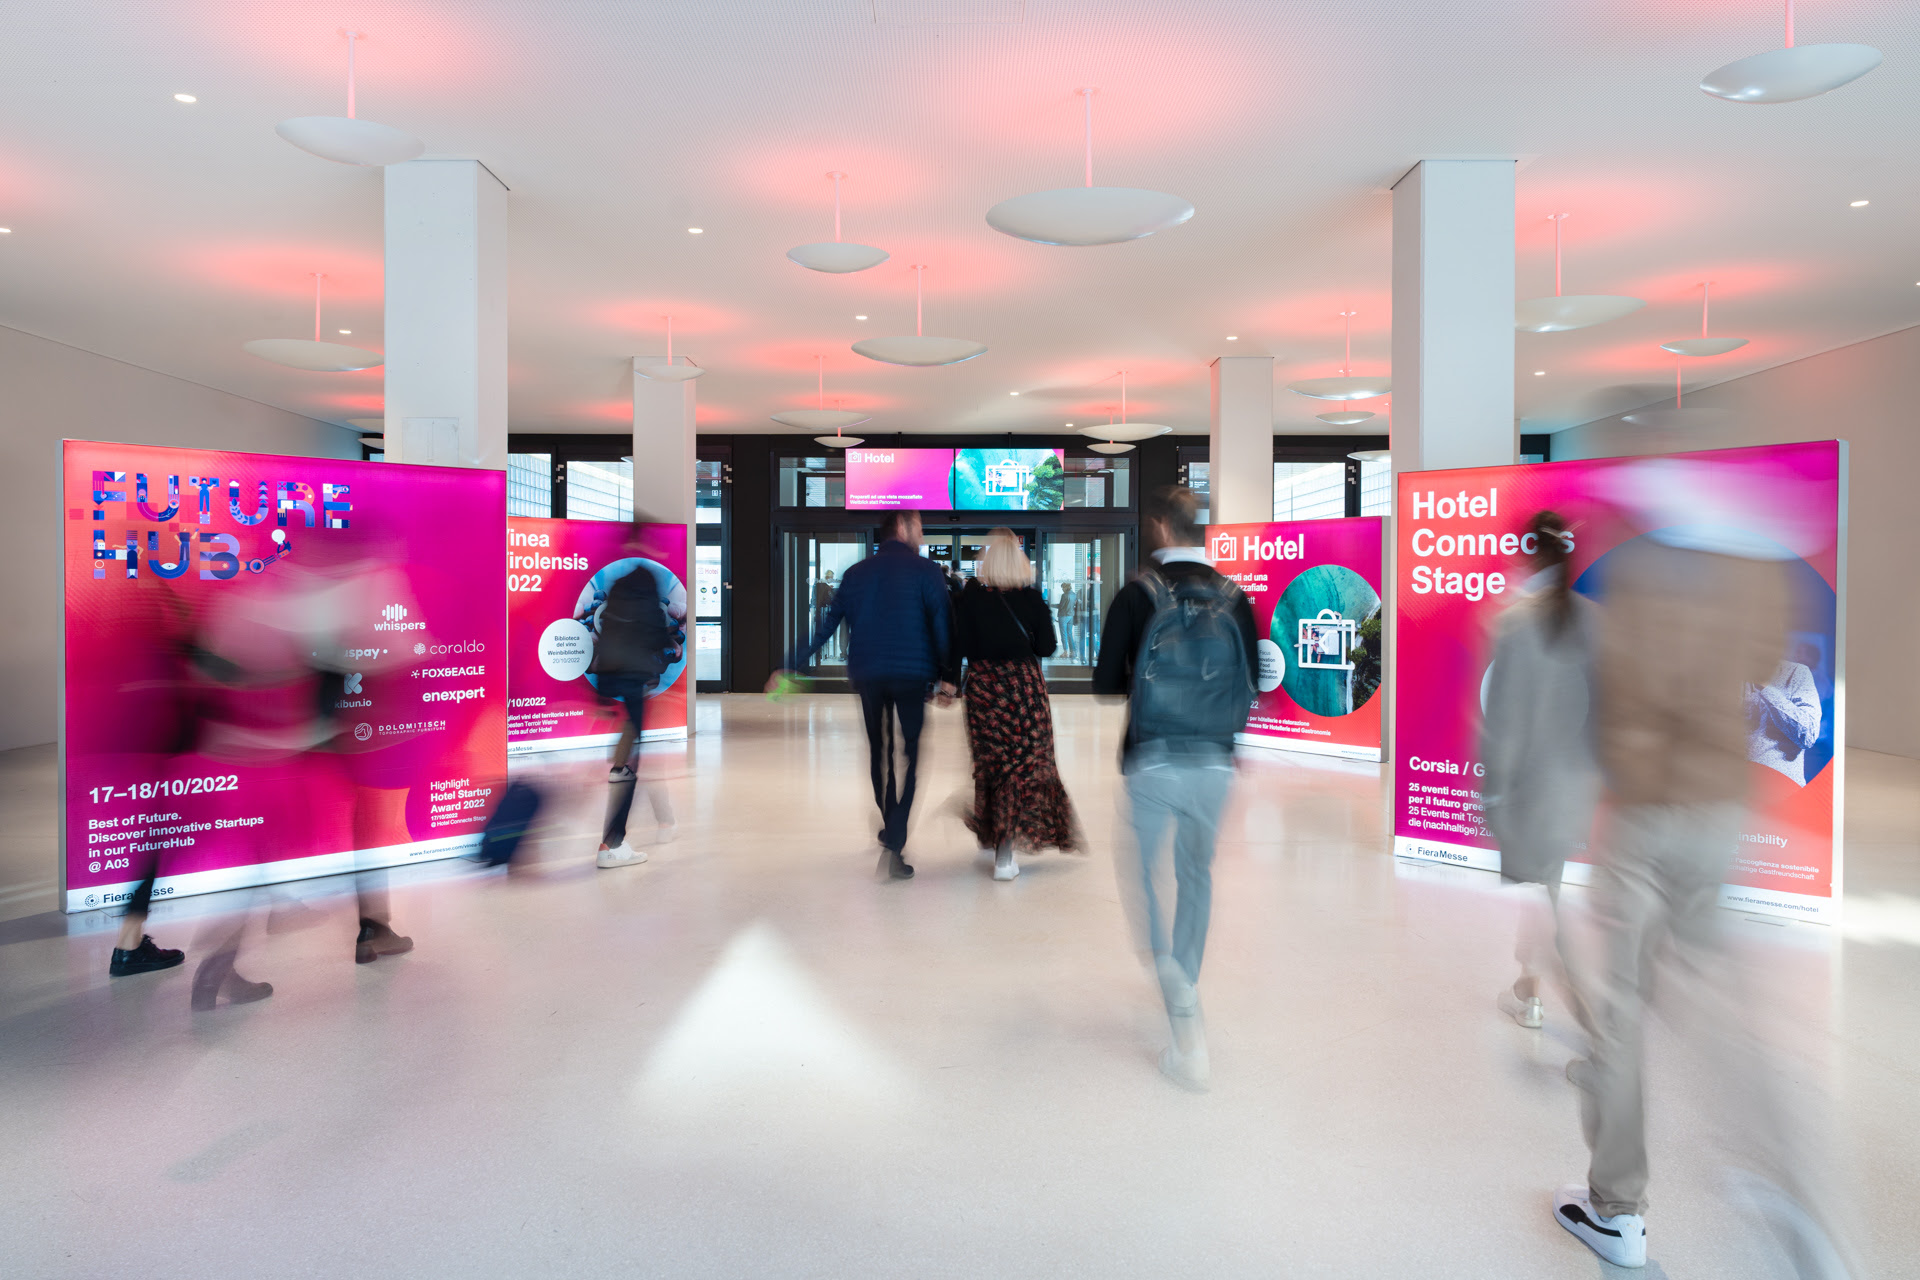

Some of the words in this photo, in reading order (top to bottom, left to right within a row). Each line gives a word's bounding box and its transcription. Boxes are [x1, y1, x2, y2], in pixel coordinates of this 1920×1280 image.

[864, 452, 895, 464] Hotel
[92, 470, 353, 529] FUTURE
[1412, 488, 1497, 520] Hotel
[1244, 533, 1304, 561] Hotel
[1412, 528, 1575, 557] Connecs
[93, 528, 240, 580] HUB
[507, 551, 589, 570] irolensis
[508, 574, 542, 592] 022
[1243, 573, 1253, 582] ad
[1254, 574, 1268, 582] una
[1412, 566, 1506, 602] Stage
[374, 621, 426, 632] whispers
[430, 639, 485, 655] coraldo
[422, 665, 486, 678] FOX&EAGLE
[422, 686, 486, 704] enexpert
[378, 720, 446, 732] DOLOMITISCH
[1409, 756, 1459, 775] Corsia
[1462, 761, 1470, 776] /
[430, 778, 470, 792] Highlight
[1408, 782, 1420, 792] 25
[1421, 785, 1449, 795] eventi
[1450, 788, 1468, 797] con
[430, 791, 456, 802] Hotel
[458, 788, 492, 799] Startup
[1408, 796, 1424, 805] per
[1425, 796, 1431, 805] il
[1433, 797, 1460, 808] futuro
[430, 802, 461, 814] Award
[463, 799, 485, 809] 2022
[1408, 806, 1420, 815] 25
[1421, 807, 1450, 819] Events
[1451, 812, 1466, 822] mit
[88, 818, 118, 830] Best
[122, 815, 136, 826] of
[138, 812, 182, 824] Future.
[1408, 818, 1422, 827] die
[1423, 820, 1478, 837] (nachhaltige)
[88, 830, 146, 844] Discover
[149, 822, 212, 836] innovative
[214, 816, 264, 829] Startups
[88, 848, 100, 858] in
[104, 848, 126, 856] our
[130, 836, 195, 854] FutureHub
[1418, 846, 1468, 862] FieraMesse
[88, 862, 101, 873] @
[104, 858, 130, 870] A03
[1758, 868, 1815, 880] Gastfreundschaft
[1780, 864, 1820, 873] sostenibile
[103, 886, 174, 904] Fierasse
[1727, 895, 1819, 913] www.fieramesse.com/hotel
